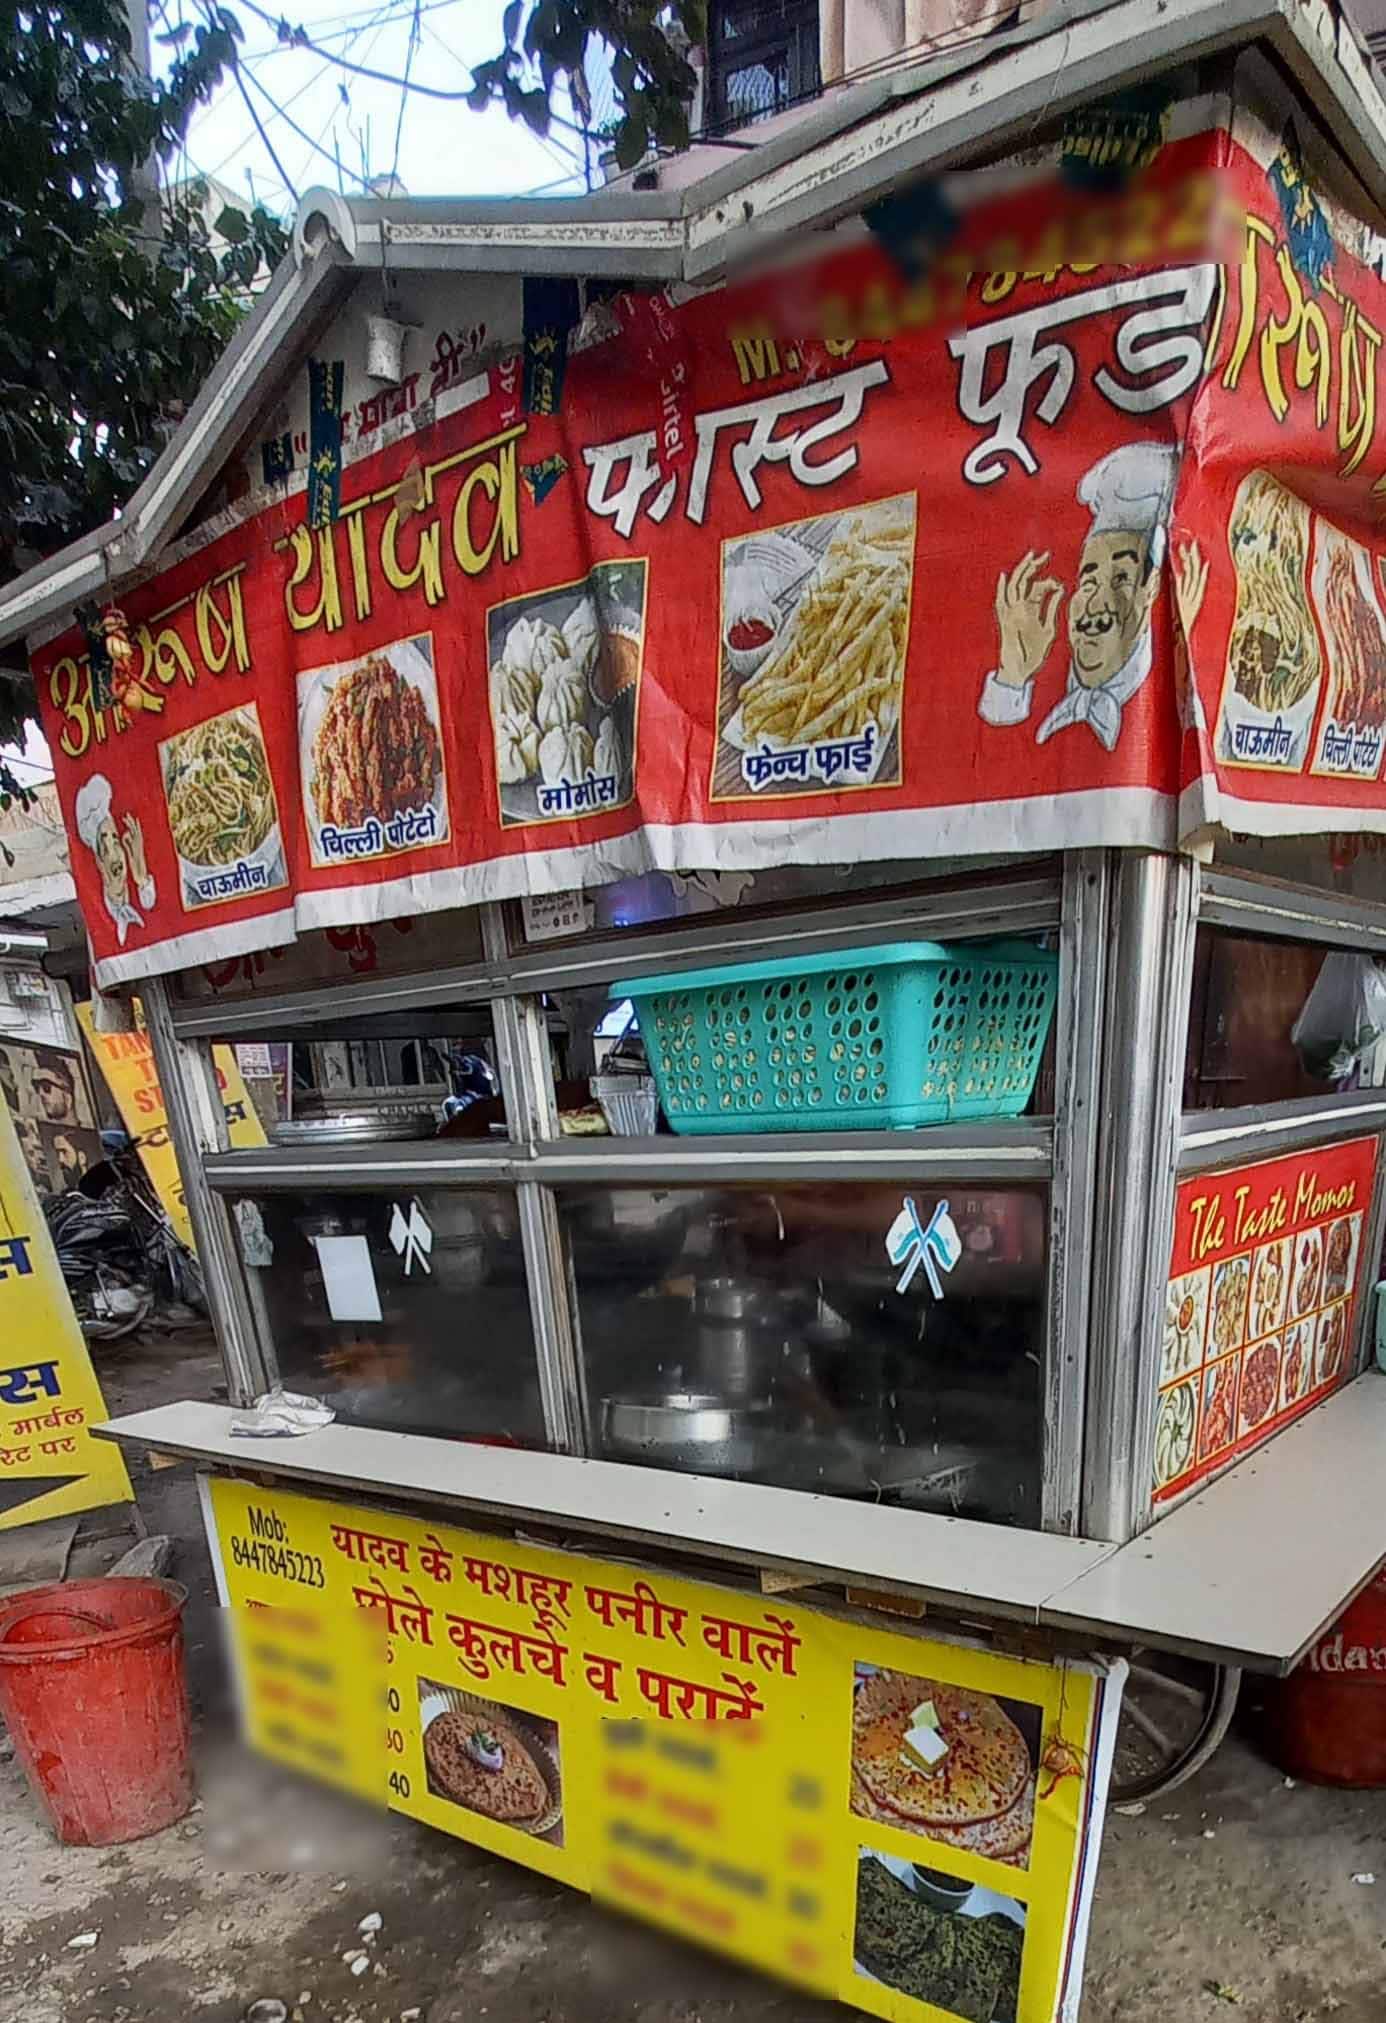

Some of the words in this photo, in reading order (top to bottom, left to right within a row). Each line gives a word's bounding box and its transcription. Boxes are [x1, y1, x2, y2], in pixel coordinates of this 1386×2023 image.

[948, 262, 1219, 486] फूड
[1235, 715, 1292, 758] चाऊमीन
[540, 773, 617, 812] मोमोस
[320, 821, 380, 857] चिल्ली
[387, 807, 436, 845] पोटेटो
[197, 862, 267, 897] चाऊमीन
[1190, 1196, 1226, 1262] The
[1234, 1185, 1288, 1245] Taste
[1291, 1171, 1357, 1225] Momos
[8, 1406, 85, 1436] मार्बल
[39, 1436, 77, 1457] पर
[247, 1505, 289, 1544] Mob:
[231, 1535, 325, 1589] 8447845223
[330, 1524, 410, 1574] यादव
[417, 1534, 454, 1583] के
[463, 1556, 573, 1631] मशहूर
[584, 1581, 689, 1647] पनीर
[701, 1614, 802, 1676] वालें
[445, 1621, 569, 1687] कुलचे
[583, 1652, 622, 1703] व
[388, 1770, 411, 1799] 40
